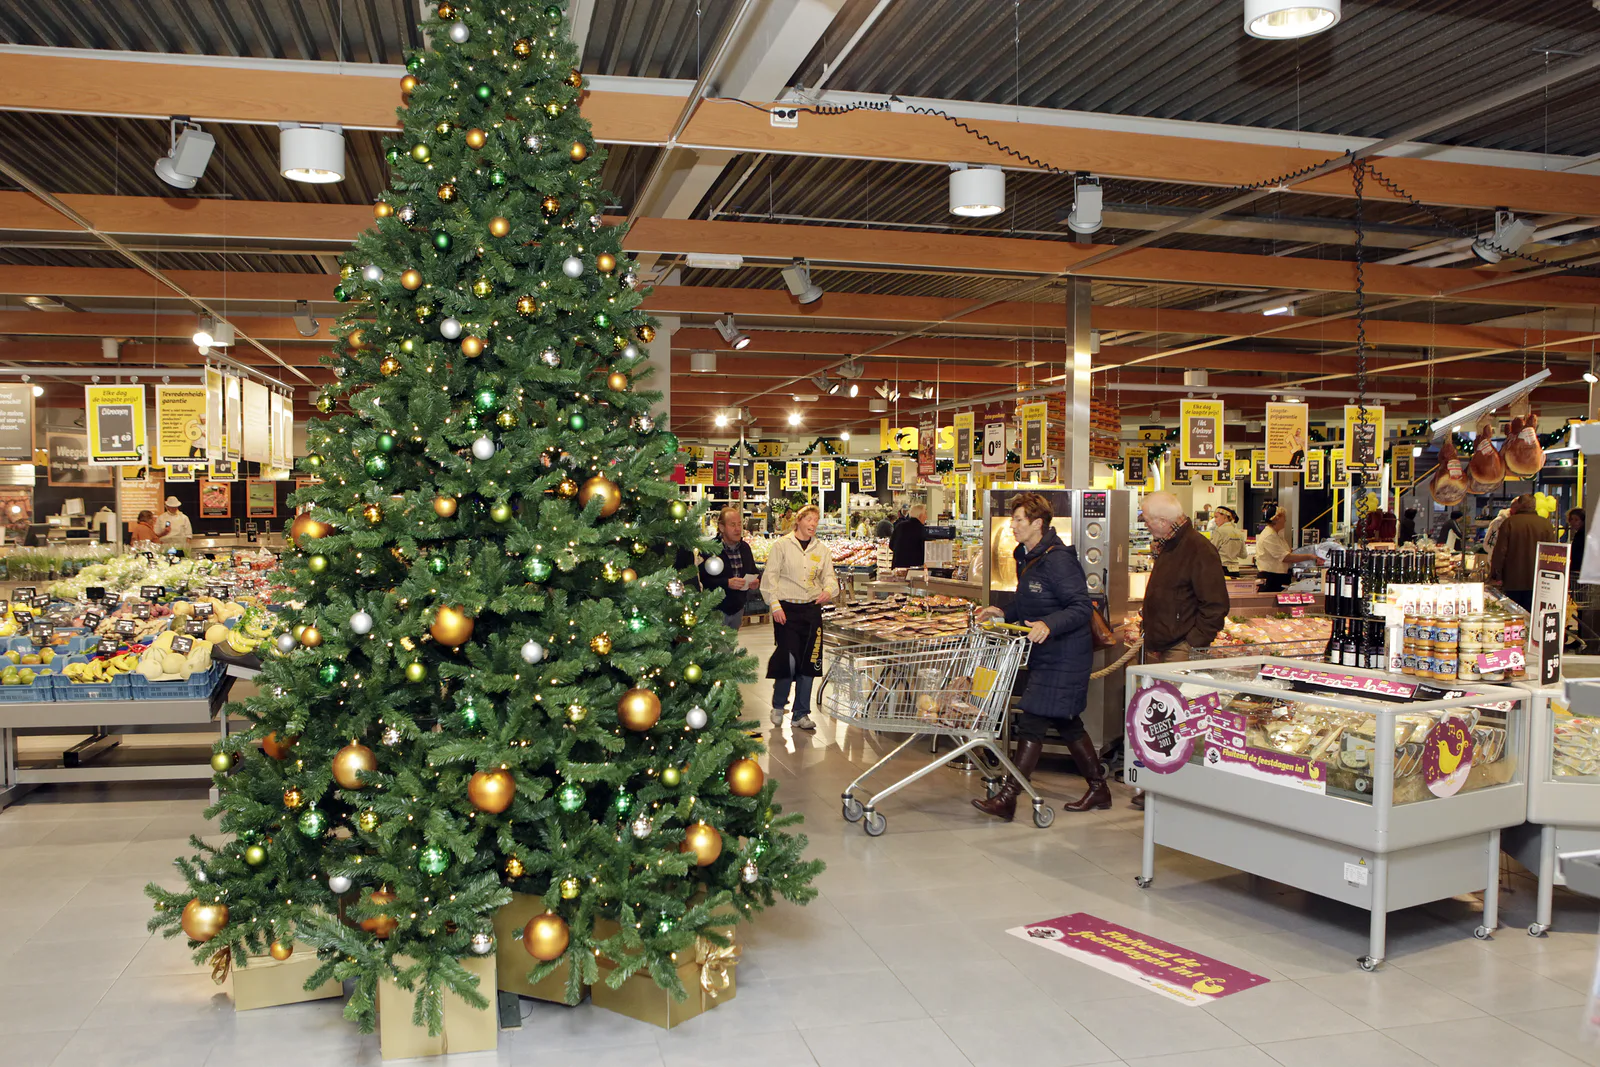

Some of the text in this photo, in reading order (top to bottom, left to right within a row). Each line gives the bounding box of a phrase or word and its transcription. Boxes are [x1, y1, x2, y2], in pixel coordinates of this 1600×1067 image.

[763, 446, 768, 454] 3
[775, 446, 778, 456] 3
[1547, 553, 1566, 566] goedkoop
[810, 627, 821, 663] JUMBO
[1149, 718, 1172, 736] FEEST
[1159, 738, 1172, 748] 2011
[1222, 748, 1305, 773] Fluitend de feestdagen in!
[1128, 768, 1137, 782] 10
[1067, 930, 1204, 978] feestdagen in!
[1101, 931, 1201, 968] Fluitend de
